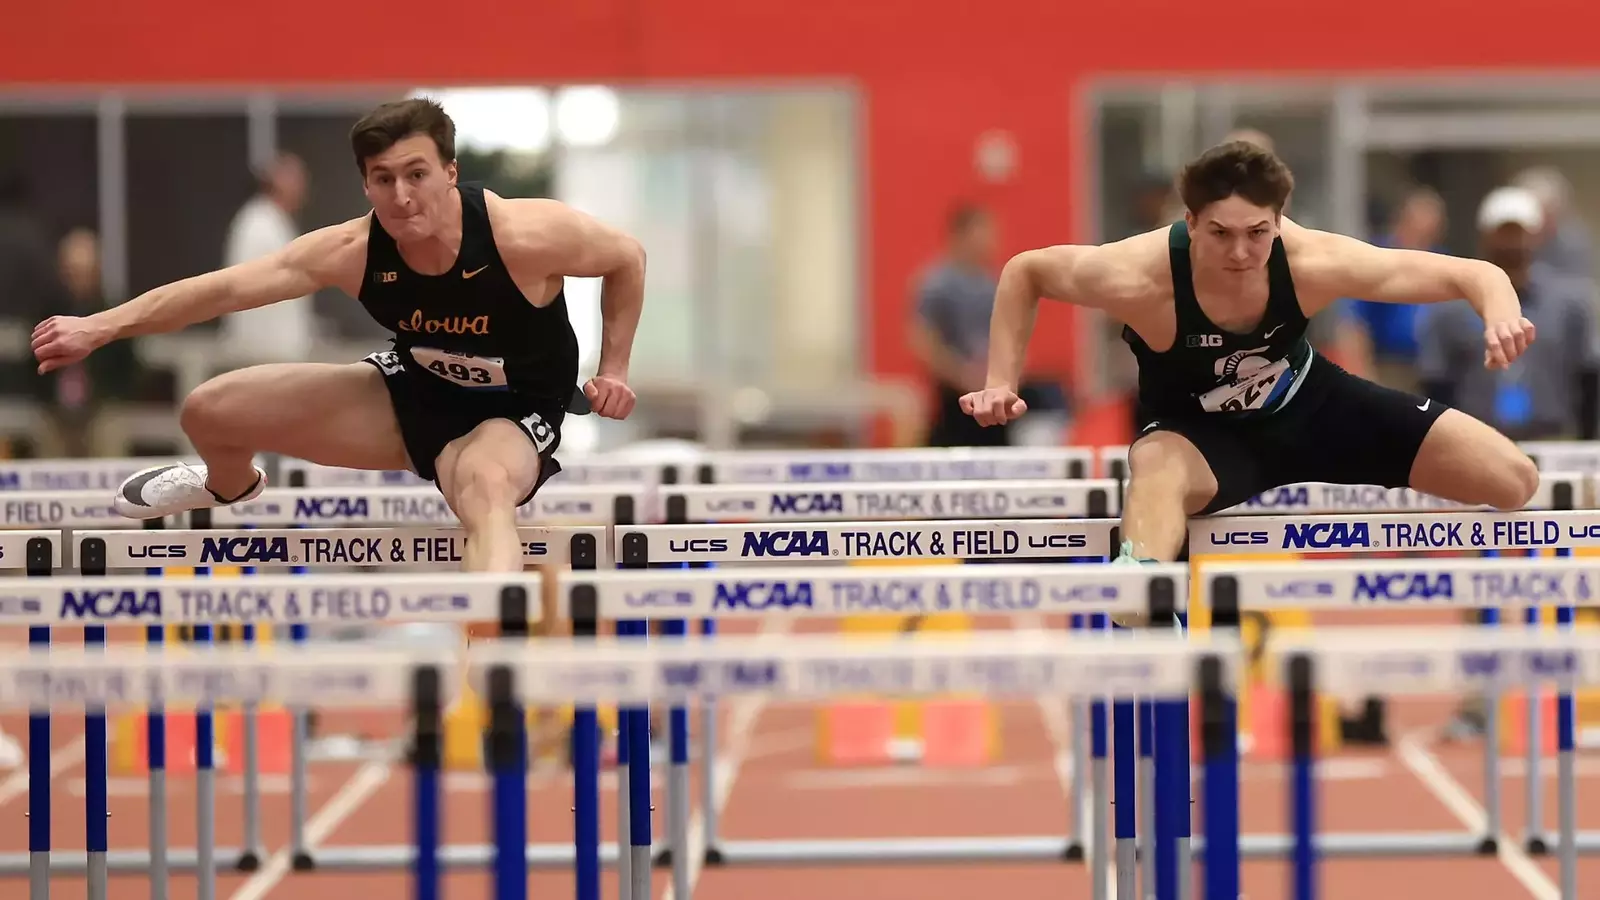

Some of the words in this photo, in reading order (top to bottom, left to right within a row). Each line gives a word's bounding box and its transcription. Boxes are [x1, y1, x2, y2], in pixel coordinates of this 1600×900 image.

[399, 309, 489, 334] Iowa
[428, 360, 491, 383] 493
[5, 501, 63, 523] FIELD
[294, 496, 368, 518] NCAA
[770, 493, 843, 514] NCAA
[856, 494, 921, 516] TRACK
[931, 493, 944, 515] &
[951, 492, 1010, 514] FIELD
[669, 539, 728, 553] UCS
[741, 530, 829, 557] NCAA
[841, 531, 922, 556] TRACK
[930, 531, 946, 556] &
[953, 530, 1019, 555] FIELD
[1028, 534, 1087, 549] UCS
[1211, 531, 1269, 545] UCS
[1282, 522, 1370, 549] NCAA
[1381, 522, 1463, 548] TRACK
[1470, 522, 1486, 547] &
[1493, 520, 1560, 546] FIELD
[1569, 525, 1600, 539] UC
[128, 545, 187, 558] UCS
[200, 537, 289, 563] NCAA
[300, 537, 383, 563] TRACK
[390, 537, 406, 562] &
[413, 537, 468, 562] FIEL
[712, 581, 813, 611] NCAA
[831, 582, 924, 611] TRACK
[961, 580, 1040, 609] FIELD
[1353, 572, 1453, 600] NCAA
[1472, 572, 1567, 600] TRACK
[60, 590, 162, 618] NCAA
[178, 589, 274, 620] TRACK
[284, 588, 301, 618] &
[311, 587, 392, 617] FIELD
